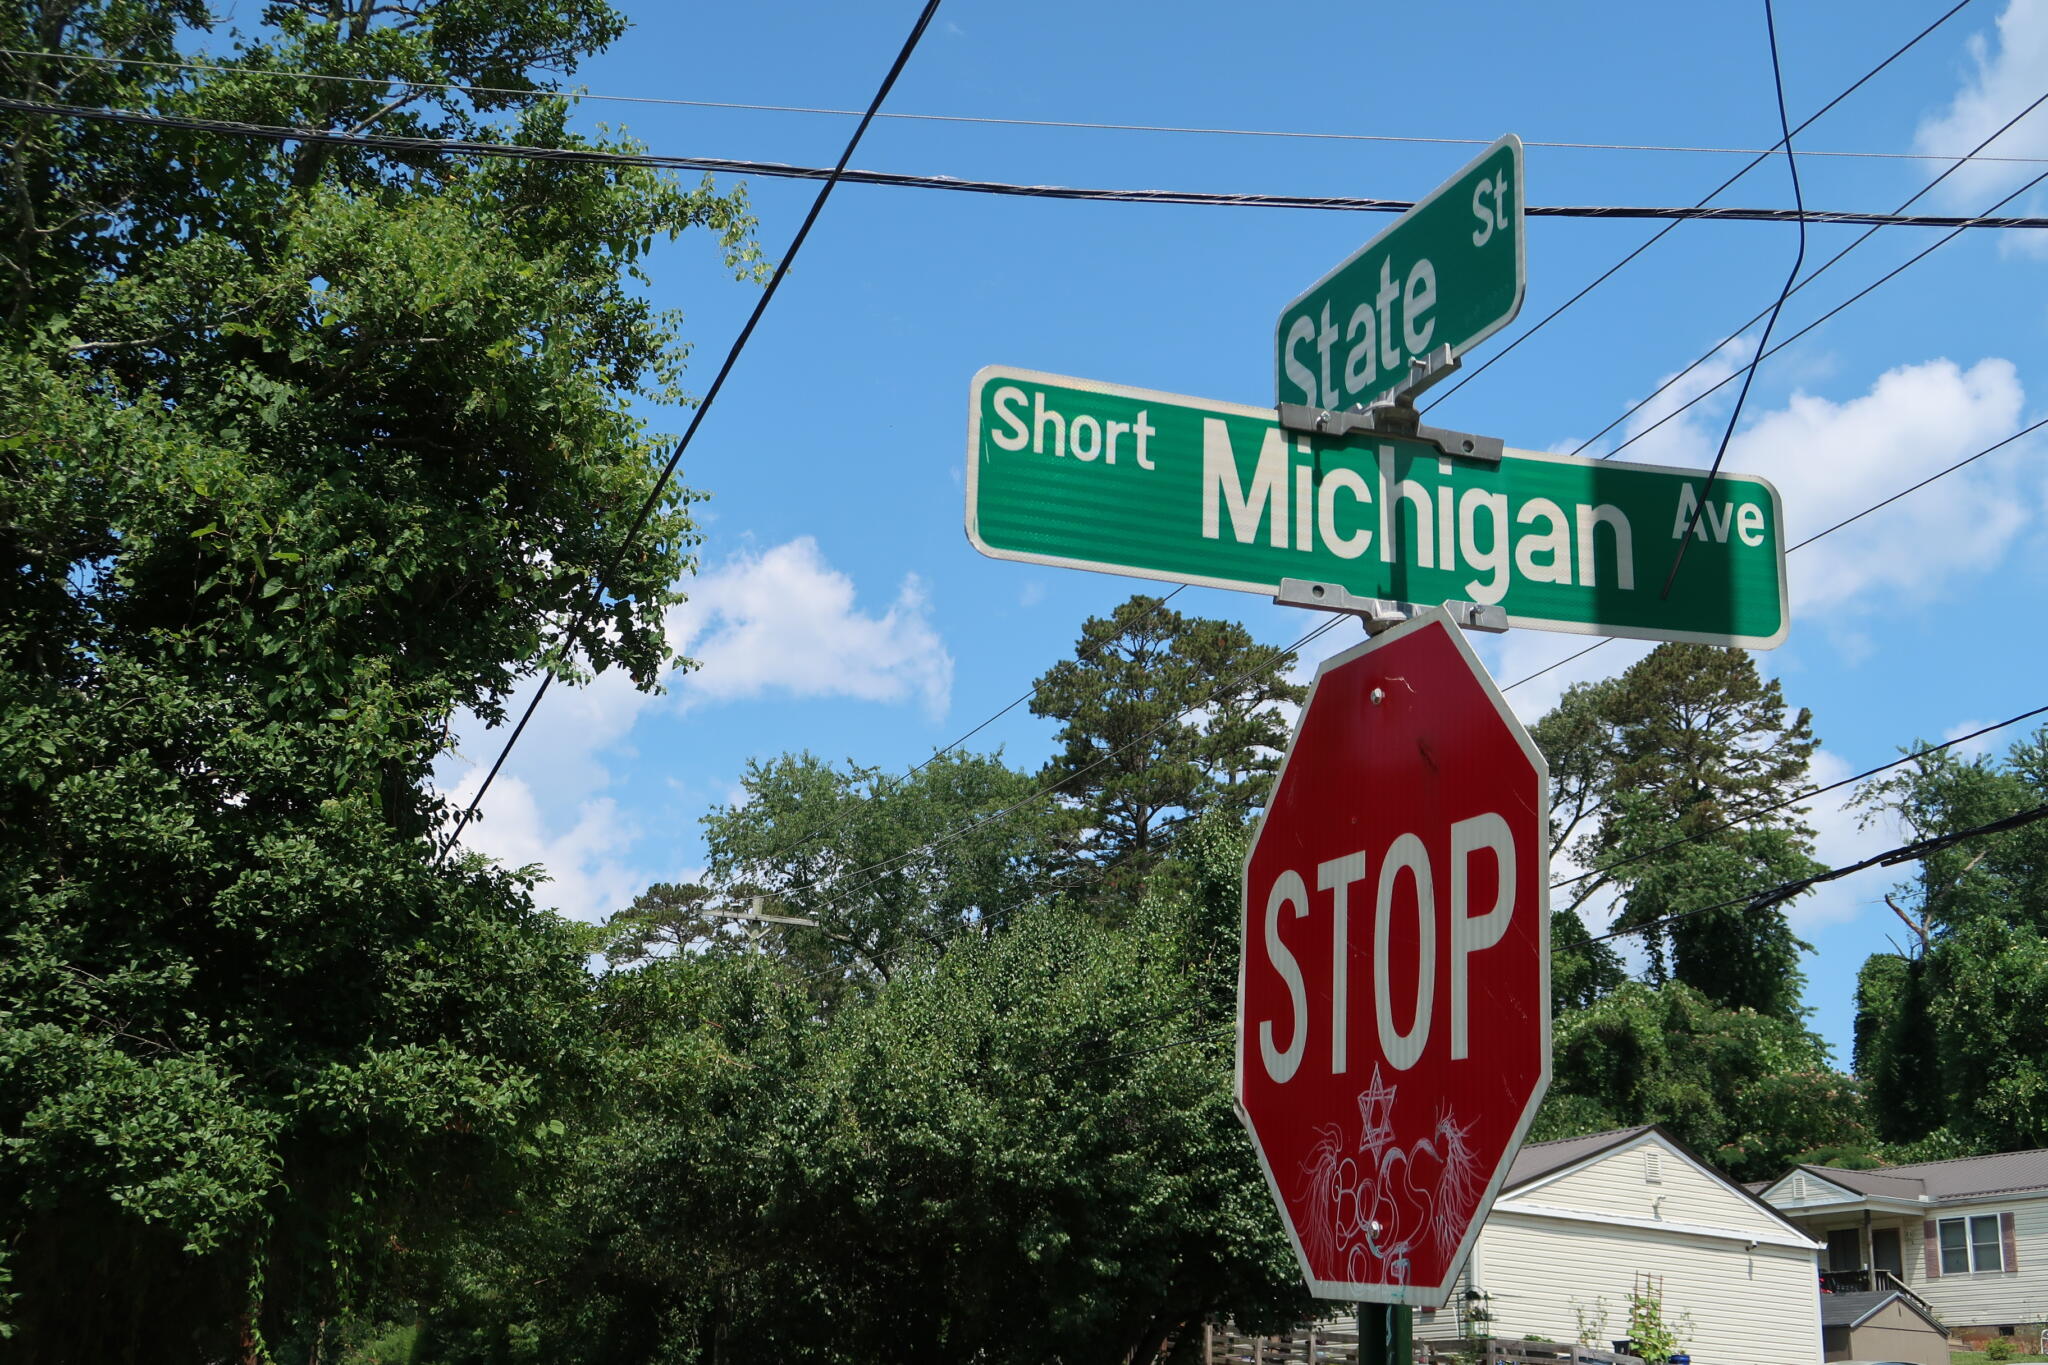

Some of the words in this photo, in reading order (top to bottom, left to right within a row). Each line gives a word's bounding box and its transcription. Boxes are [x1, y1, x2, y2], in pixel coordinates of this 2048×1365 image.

[1285, 254, 1437, 411] State
[1472, 168, 1508, 247] St
[991, 386, 1156, 471] Short
[1202, 416, 1635, 606] Michigan
[1672, 482, 1765, 547] Ave
[1259, 812, 1517, 1084] STOP
